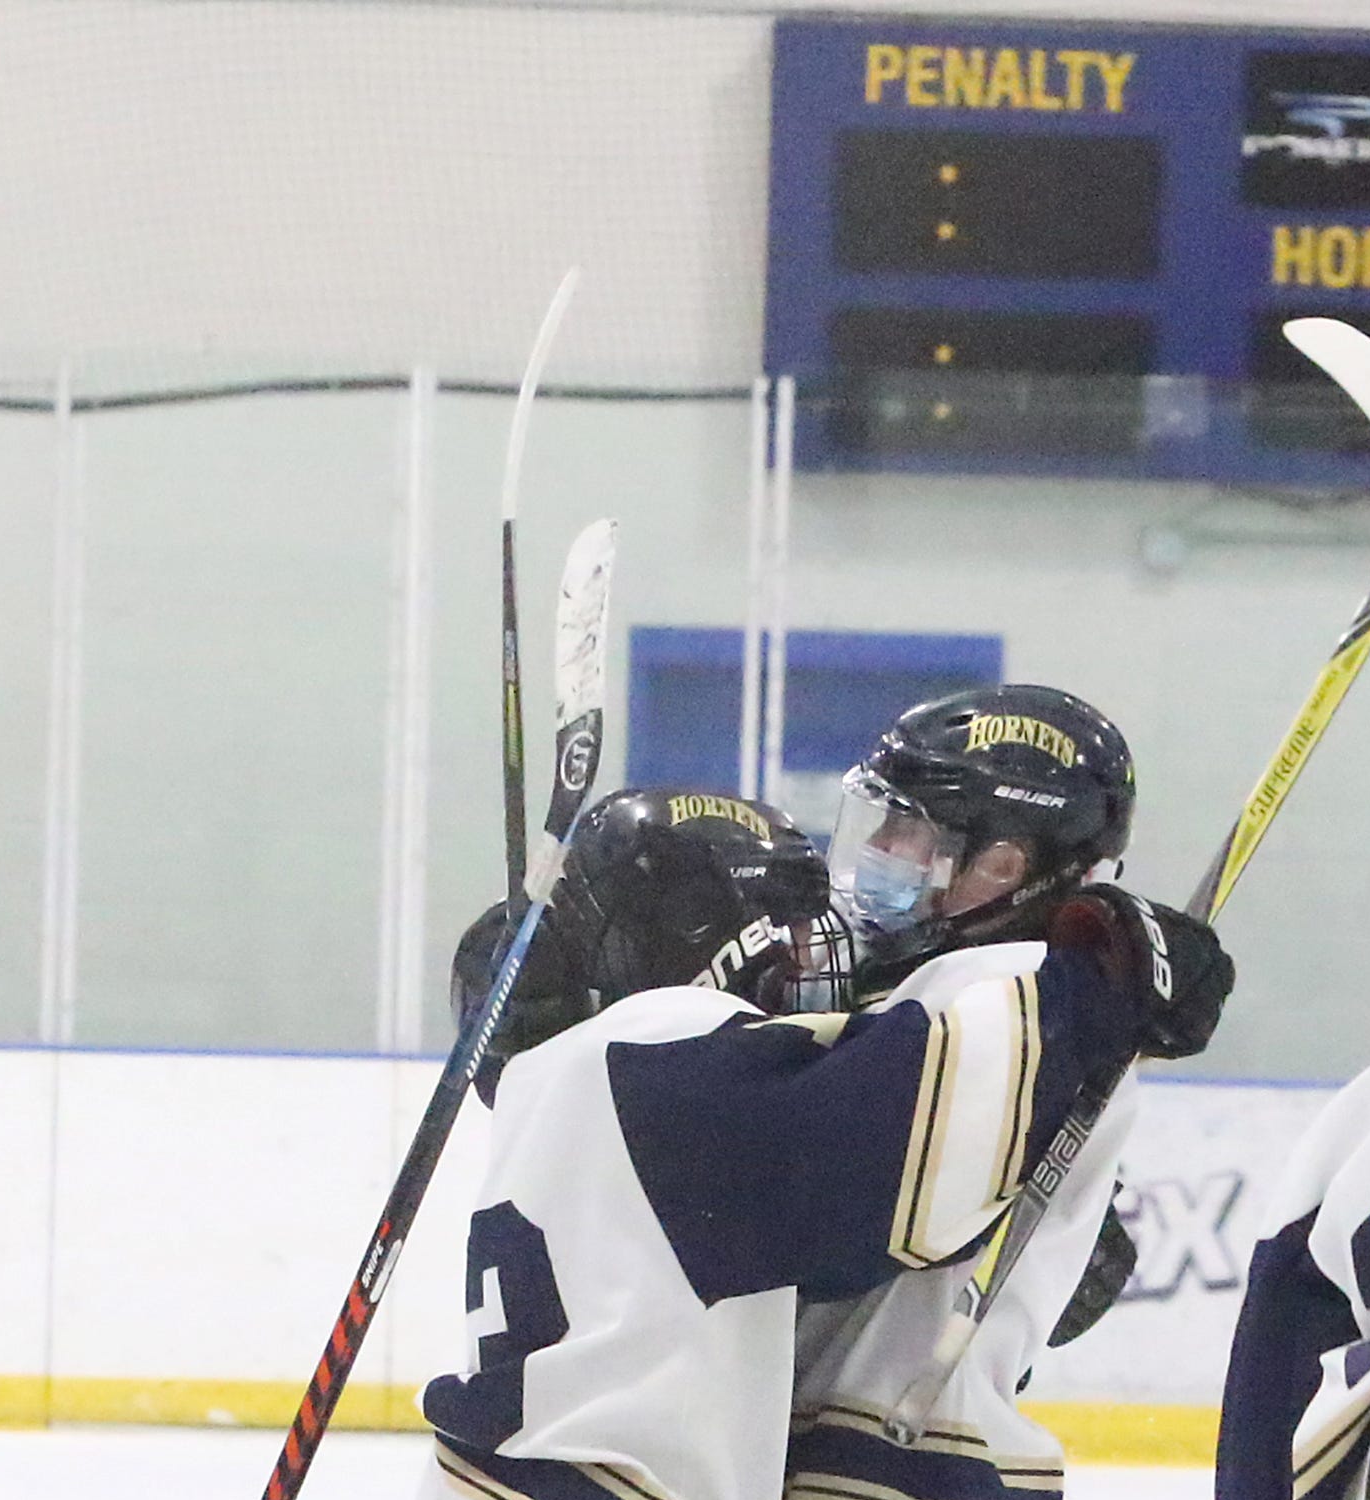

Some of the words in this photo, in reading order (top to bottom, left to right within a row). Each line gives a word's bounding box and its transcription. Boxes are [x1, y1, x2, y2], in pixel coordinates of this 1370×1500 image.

[866, 44, 1137, 113] PENALTY
[964, 714, 1078, 769] HORNETS
[668, 795, 773, 844] HORNETS
